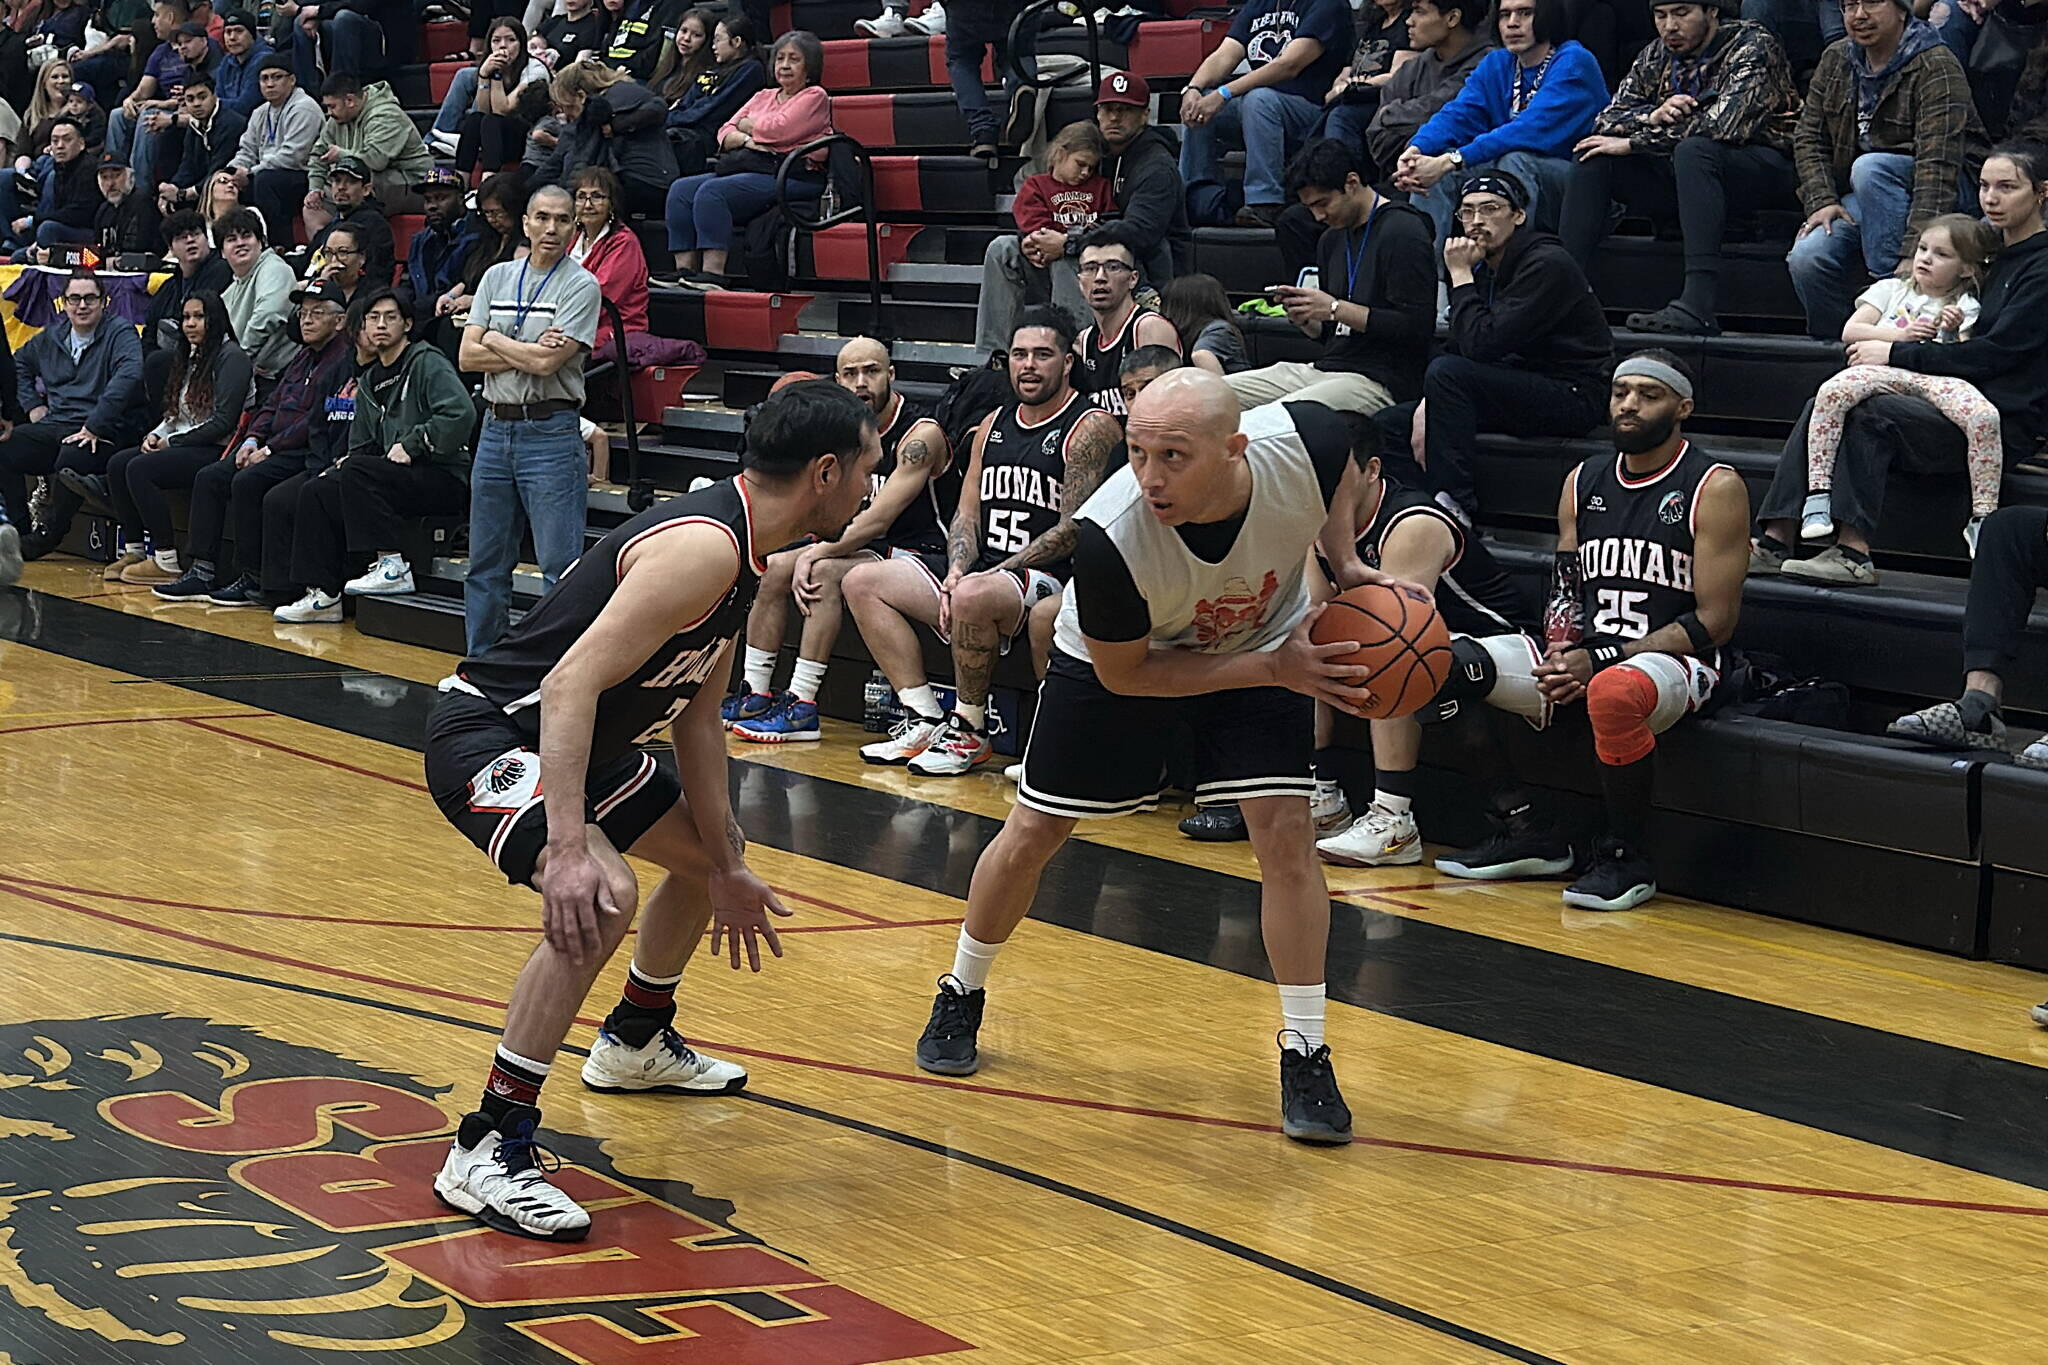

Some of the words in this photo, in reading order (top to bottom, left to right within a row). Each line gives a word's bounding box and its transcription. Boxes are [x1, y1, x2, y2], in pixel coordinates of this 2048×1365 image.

[981, 466, 1063, 512] OONAH
[987, 508, 1030, 553] 55
[1594, 588, 1649, 639] 25
